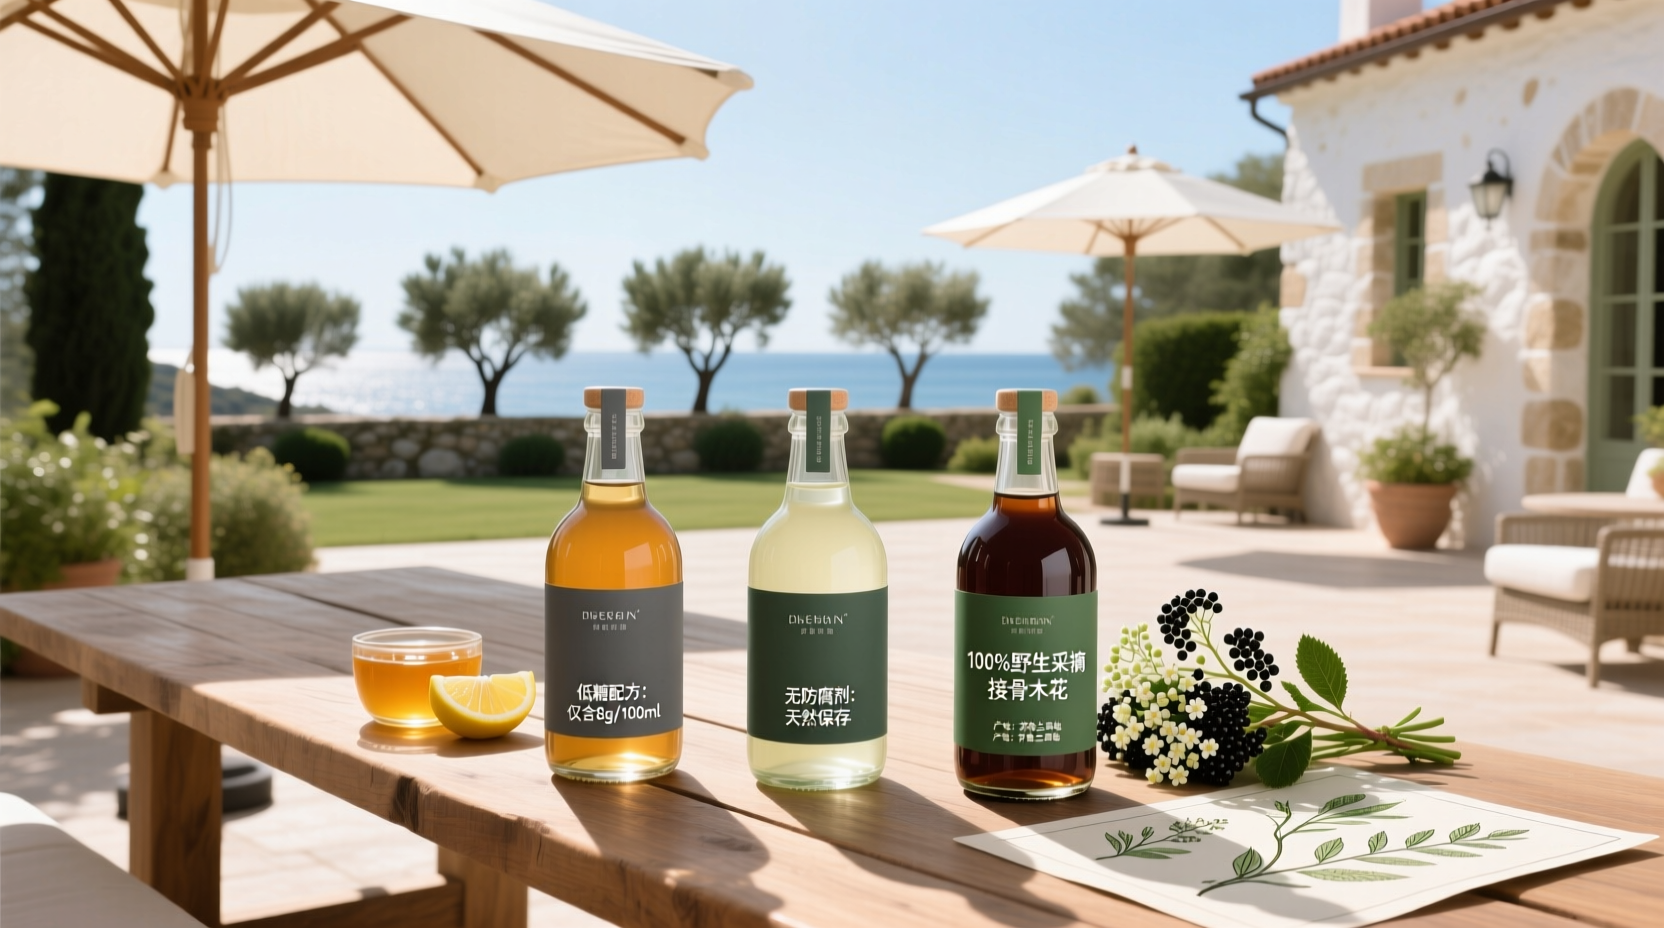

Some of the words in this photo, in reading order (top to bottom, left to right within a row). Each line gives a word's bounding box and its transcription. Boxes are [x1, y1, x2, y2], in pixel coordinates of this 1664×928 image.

[987, 677, 1069, 702] 接骨木花
[785, 707, 852, 727] 天然保存
